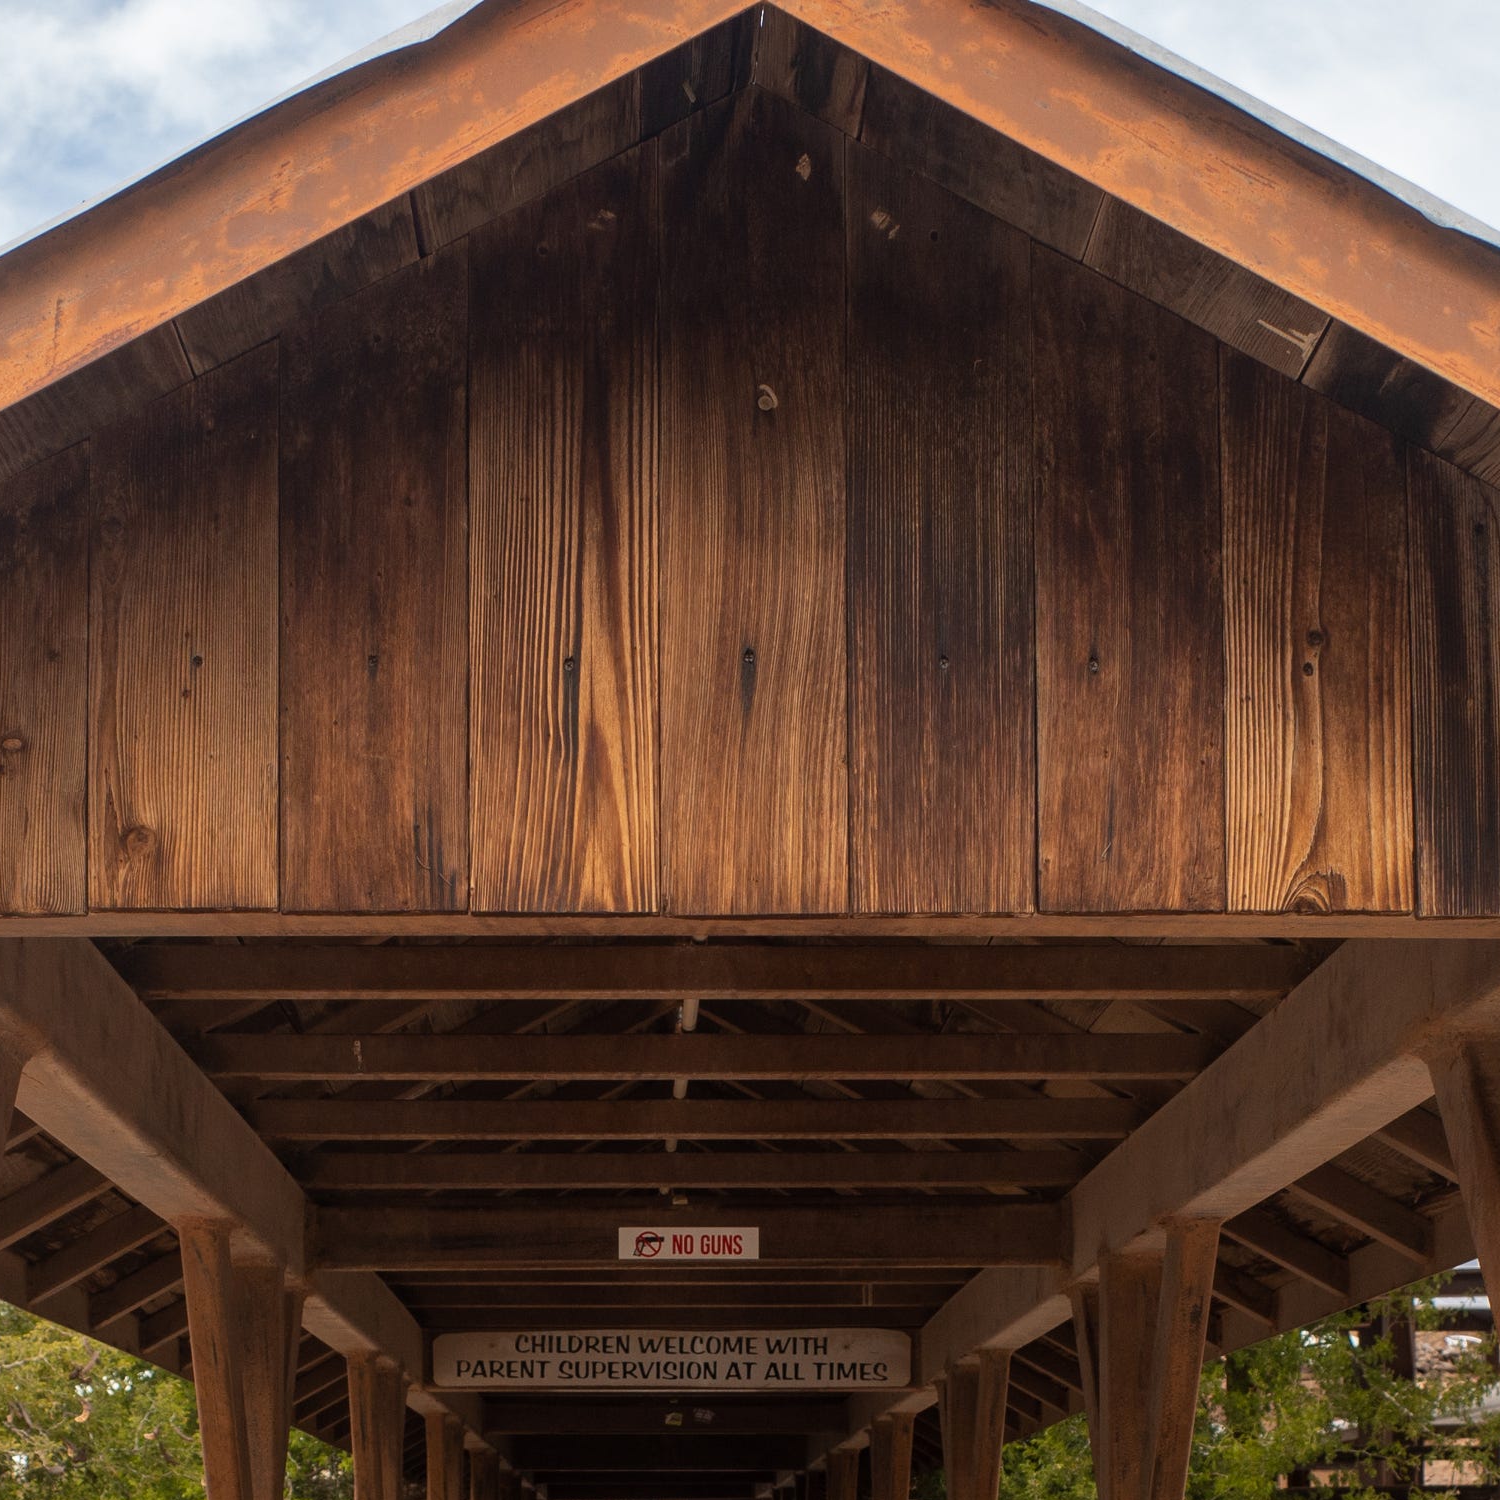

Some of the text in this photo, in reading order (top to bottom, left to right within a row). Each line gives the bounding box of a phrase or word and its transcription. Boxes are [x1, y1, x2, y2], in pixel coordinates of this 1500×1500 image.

[672, 1234, 743, 1255] NO GUNS
[514, 1334, 829, 1356] CHILDREN WELCOME WITH
[455, 1359, 888, 1382] PARENT SUPERVISION AT ALL TIMES
